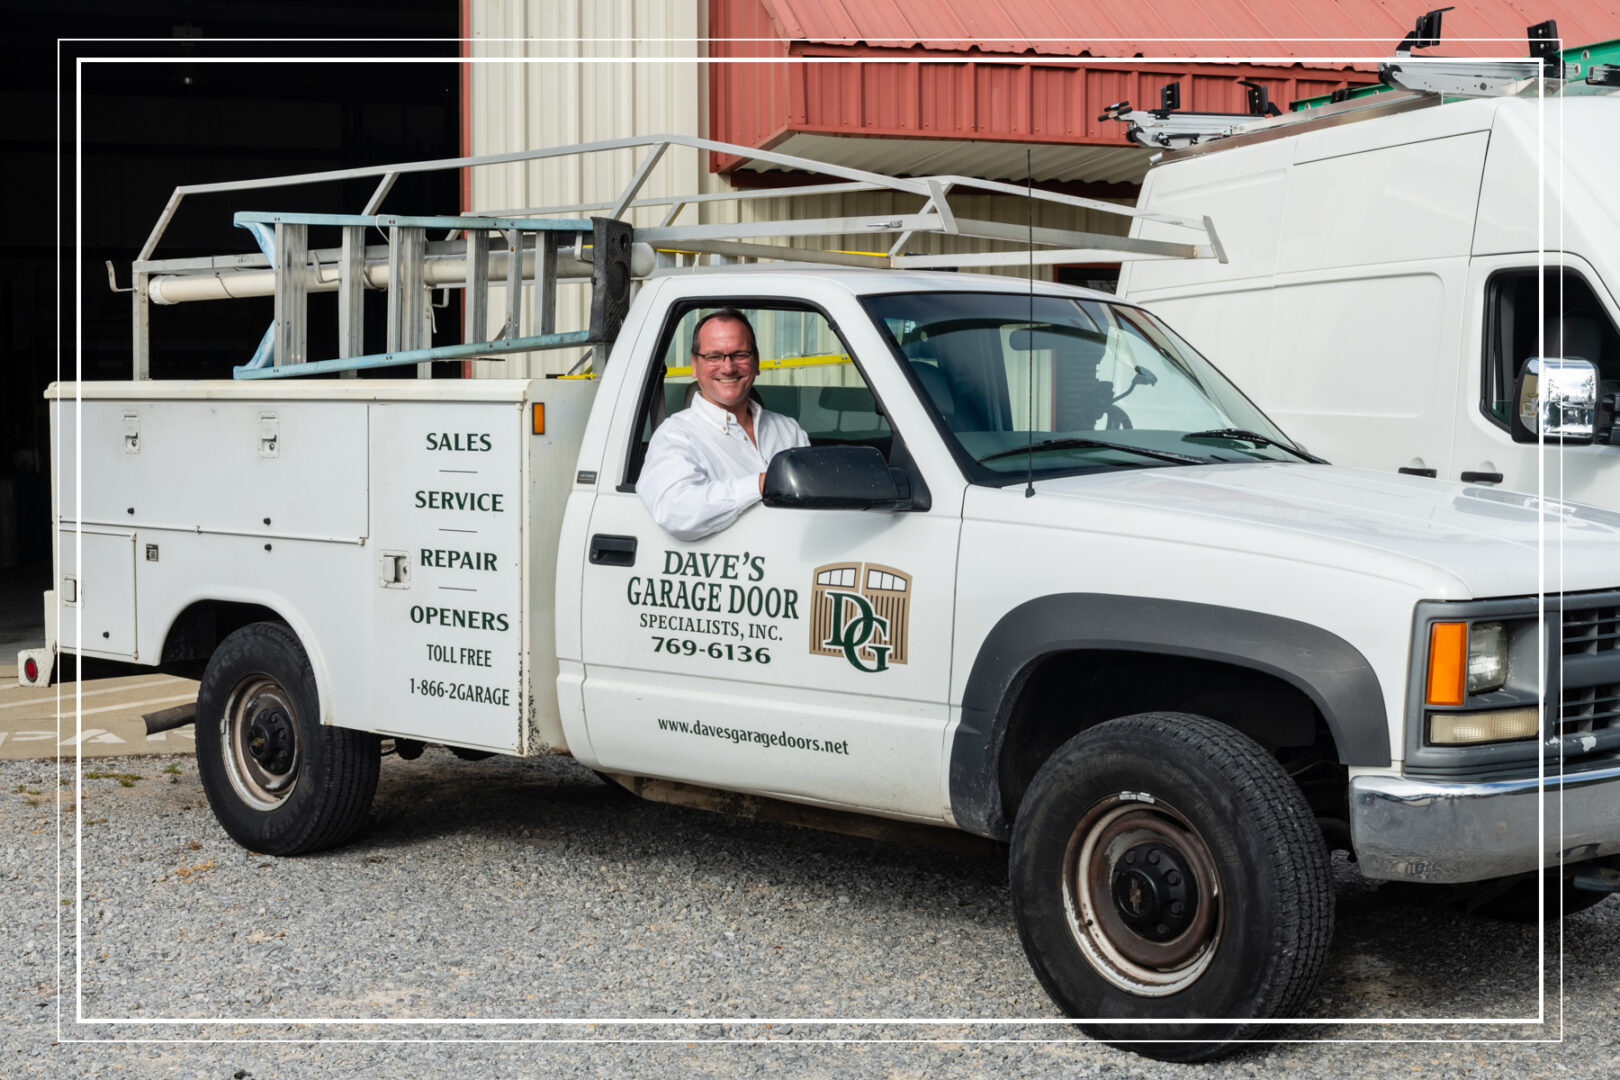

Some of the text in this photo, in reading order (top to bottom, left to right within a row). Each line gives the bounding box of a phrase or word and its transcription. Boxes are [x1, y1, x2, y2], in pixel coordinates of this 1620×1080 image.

[426, 432, 493, 452] SALES
[414, 490, 505, 513] SERVICE
[420, 548, 498, 572] REPAIR
[662, 550, 766, 583] DAVE'S
[626, 575, 800, 620] GARAGE DOOR
[409, 605, 510, 632] OPENERS
[639, 612, 784, 642] SPECIALISTS, INC.
[426, 643, 493, 668] TOLL FREE
[651, 636, 772, 665] 769-6136
[409, 677, 510, 707] 1-866-2GARAGE
[657, 717, 850, 756] www.davesgaragedoors.net
